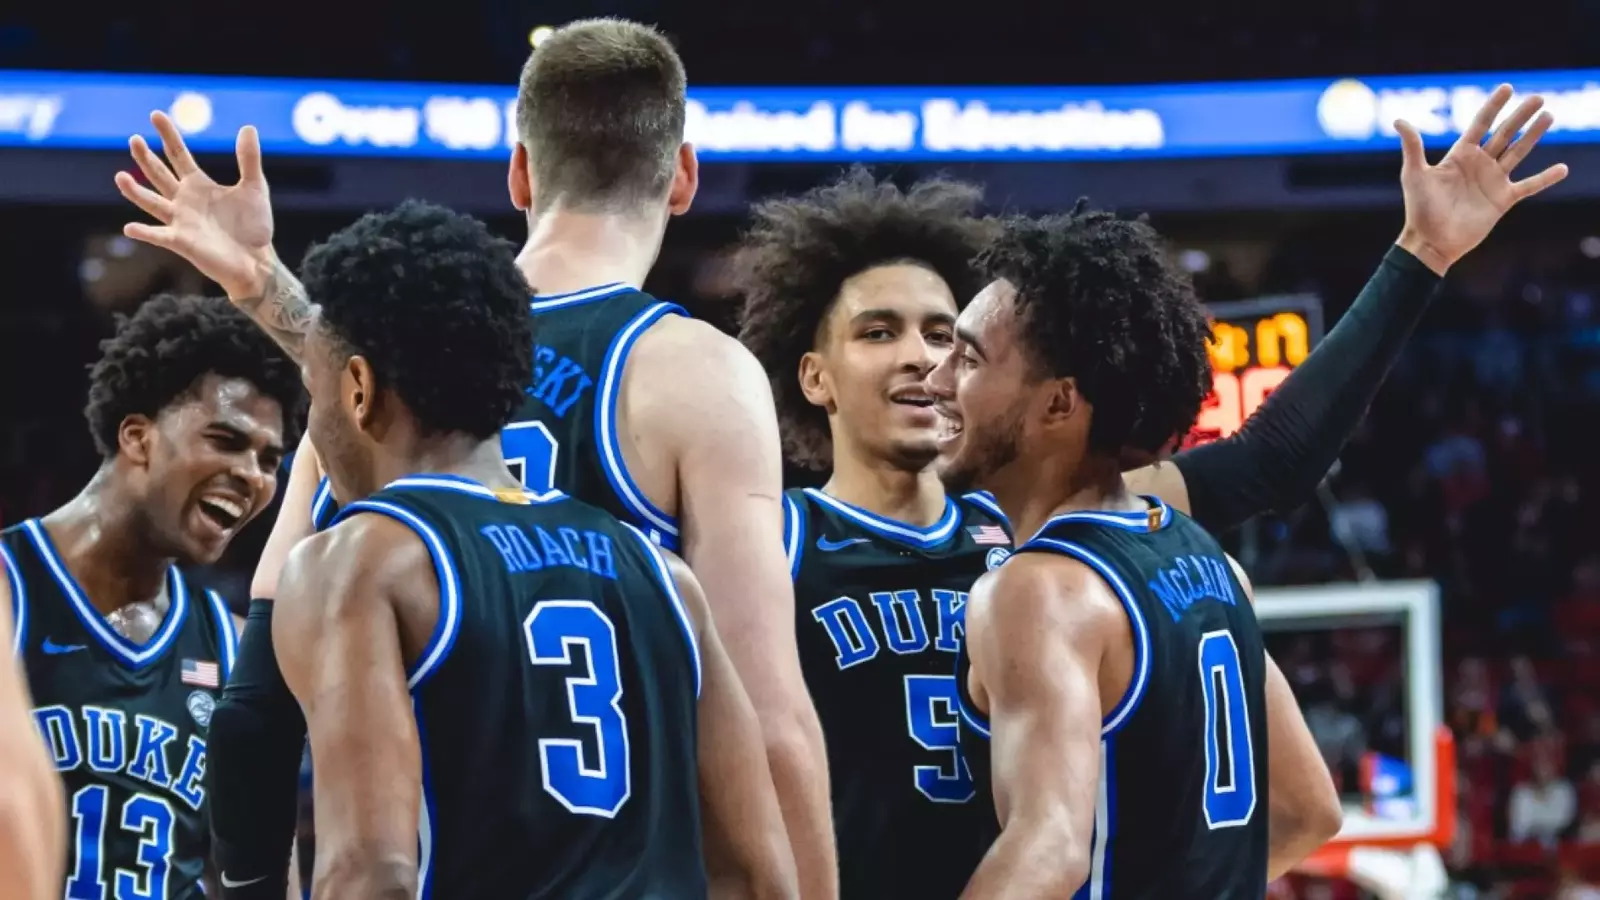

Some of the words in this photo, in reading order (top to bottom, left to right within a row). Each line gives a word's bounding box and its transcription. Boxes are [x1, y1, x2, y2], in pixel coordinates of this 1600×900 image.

[481, 524, 617, 580] ROACH
[811, 589, 969, 671] DUK
[32, 704, 206, 811] DUKE
[523, 600, 631, 818] 3
[903, 674, 976, 803] 5
[1198, 629, 1256, 829] 0
[64, 784, 175, 900] 13
